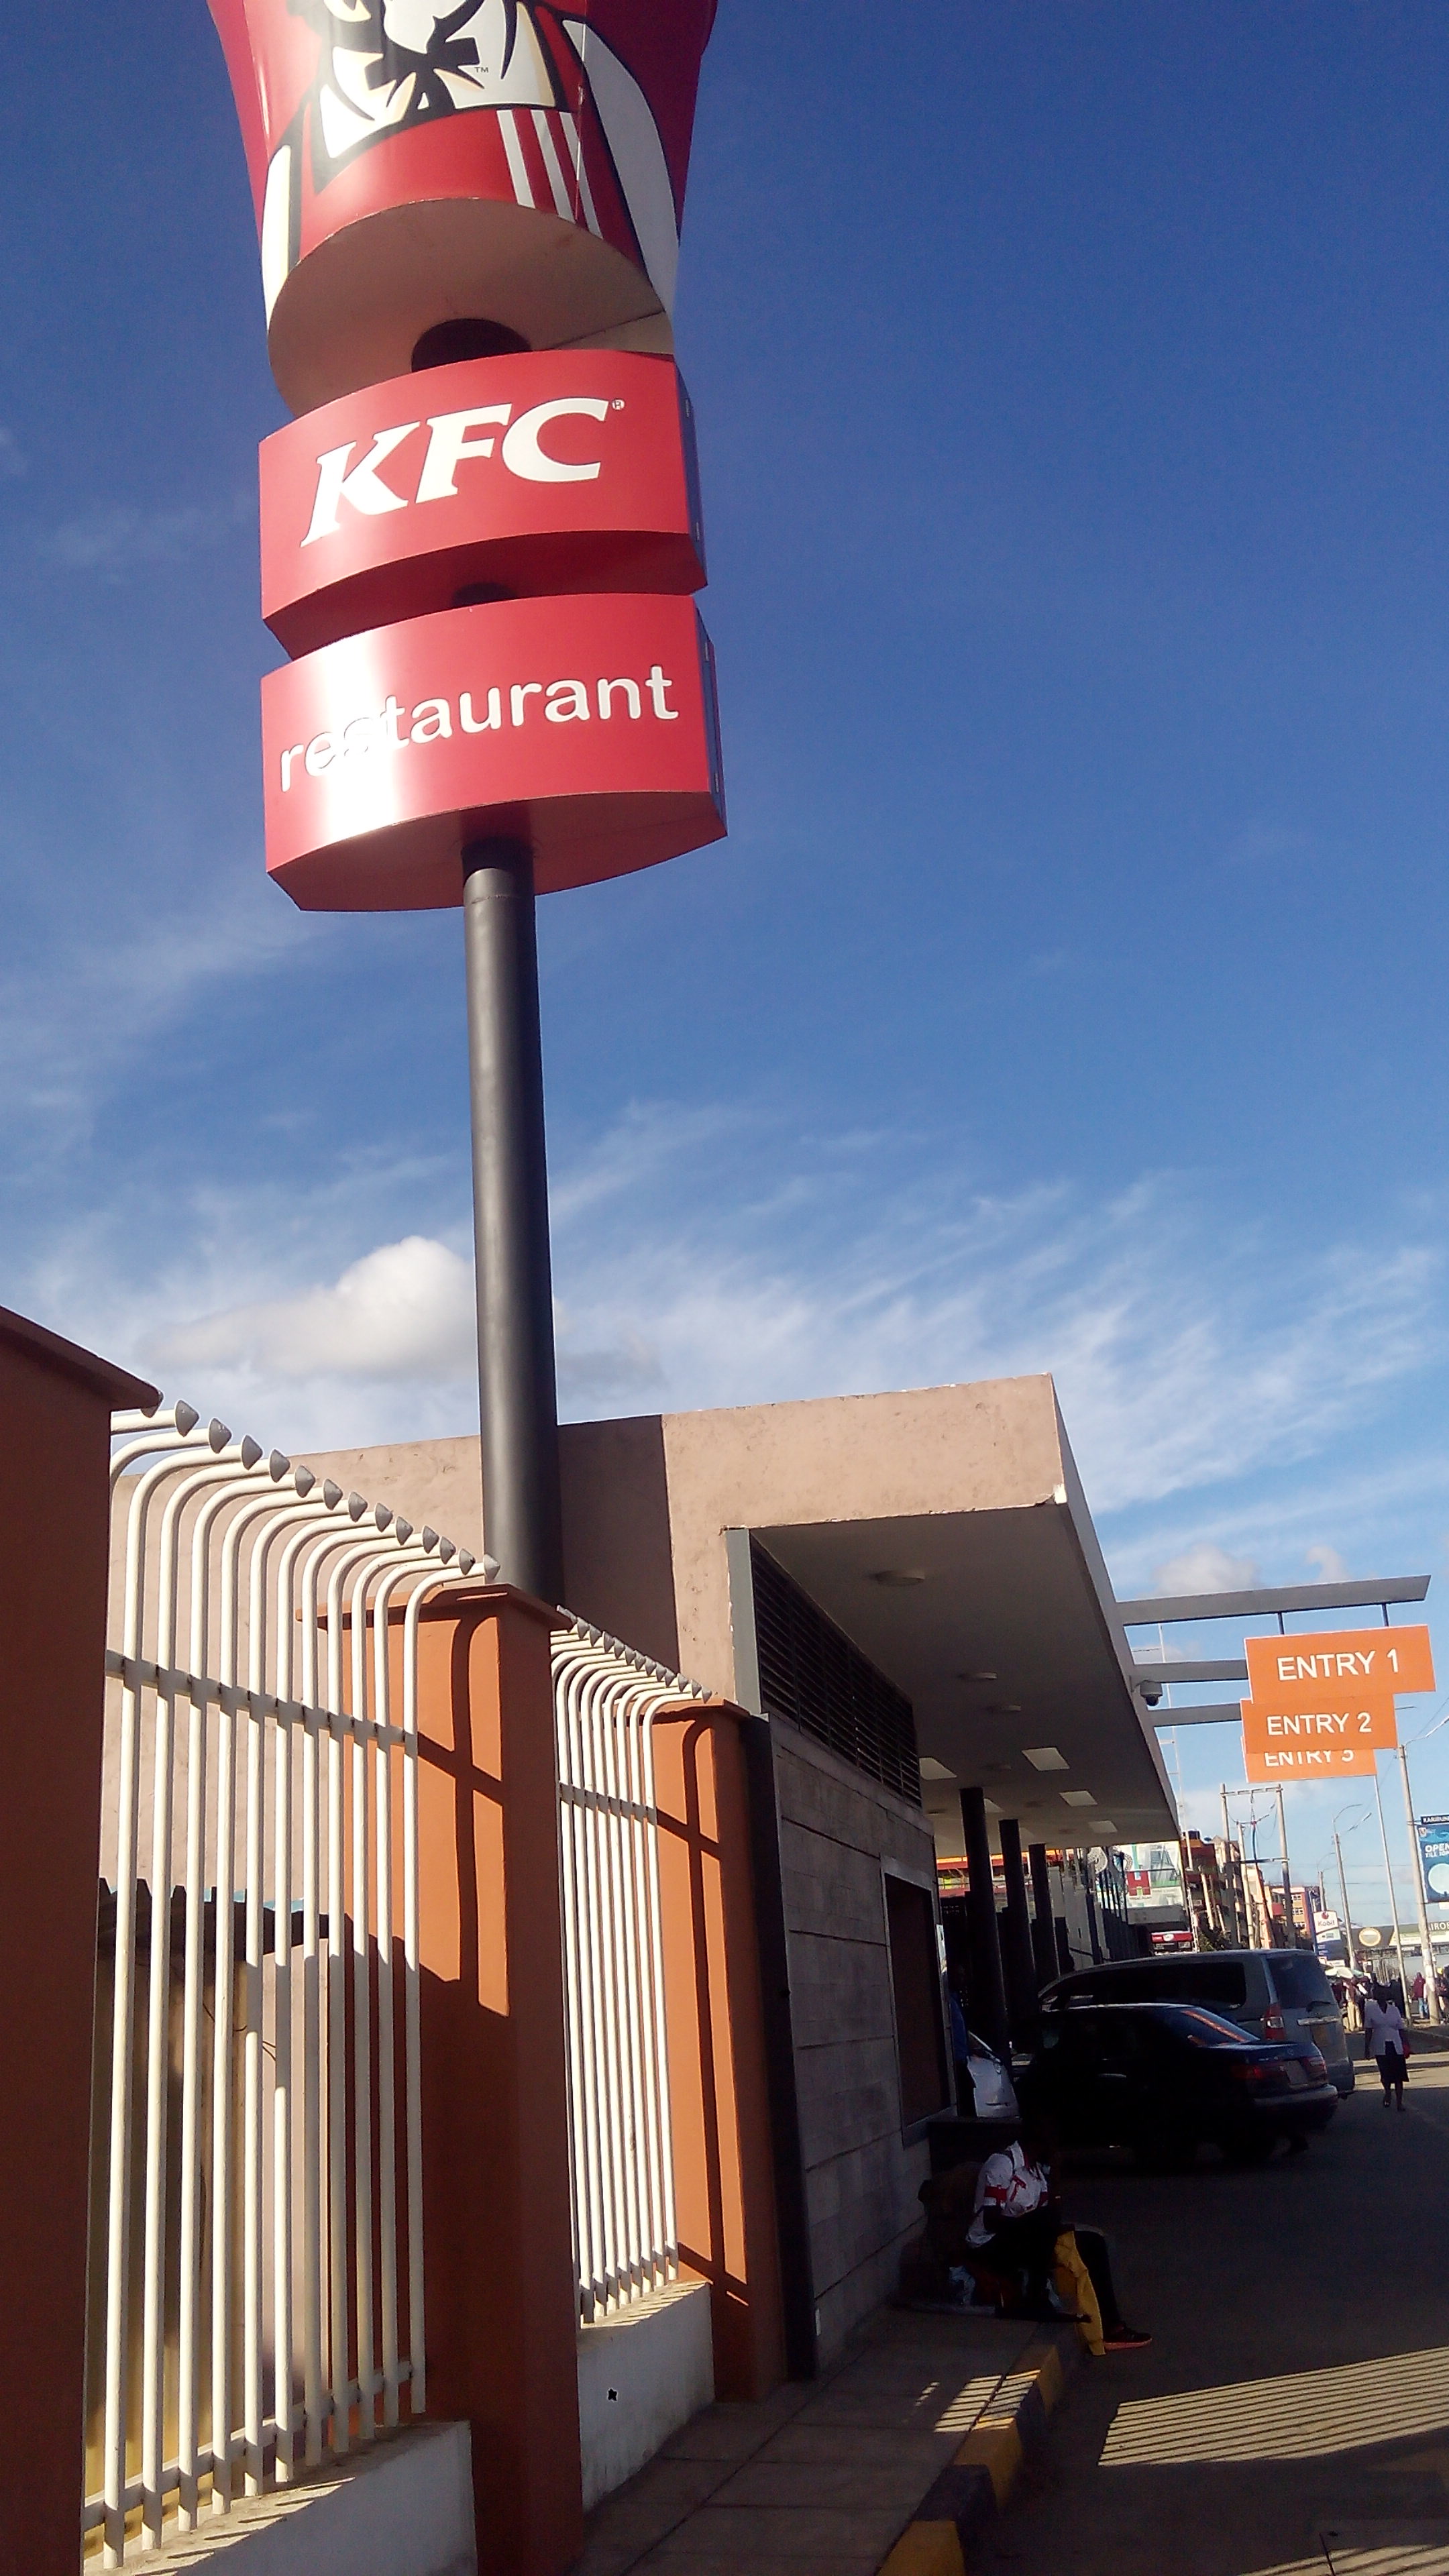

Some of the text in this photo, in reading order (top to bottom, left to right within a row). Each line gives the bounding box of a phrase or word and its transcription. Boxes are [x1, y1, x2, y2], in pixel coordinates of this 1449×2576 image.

[301, 397, 609, 549] KFC
[1277, 1648, 1399, 1680] ENTRY 1
[1267, 1712, 1372, 1735] ENTRY 2
